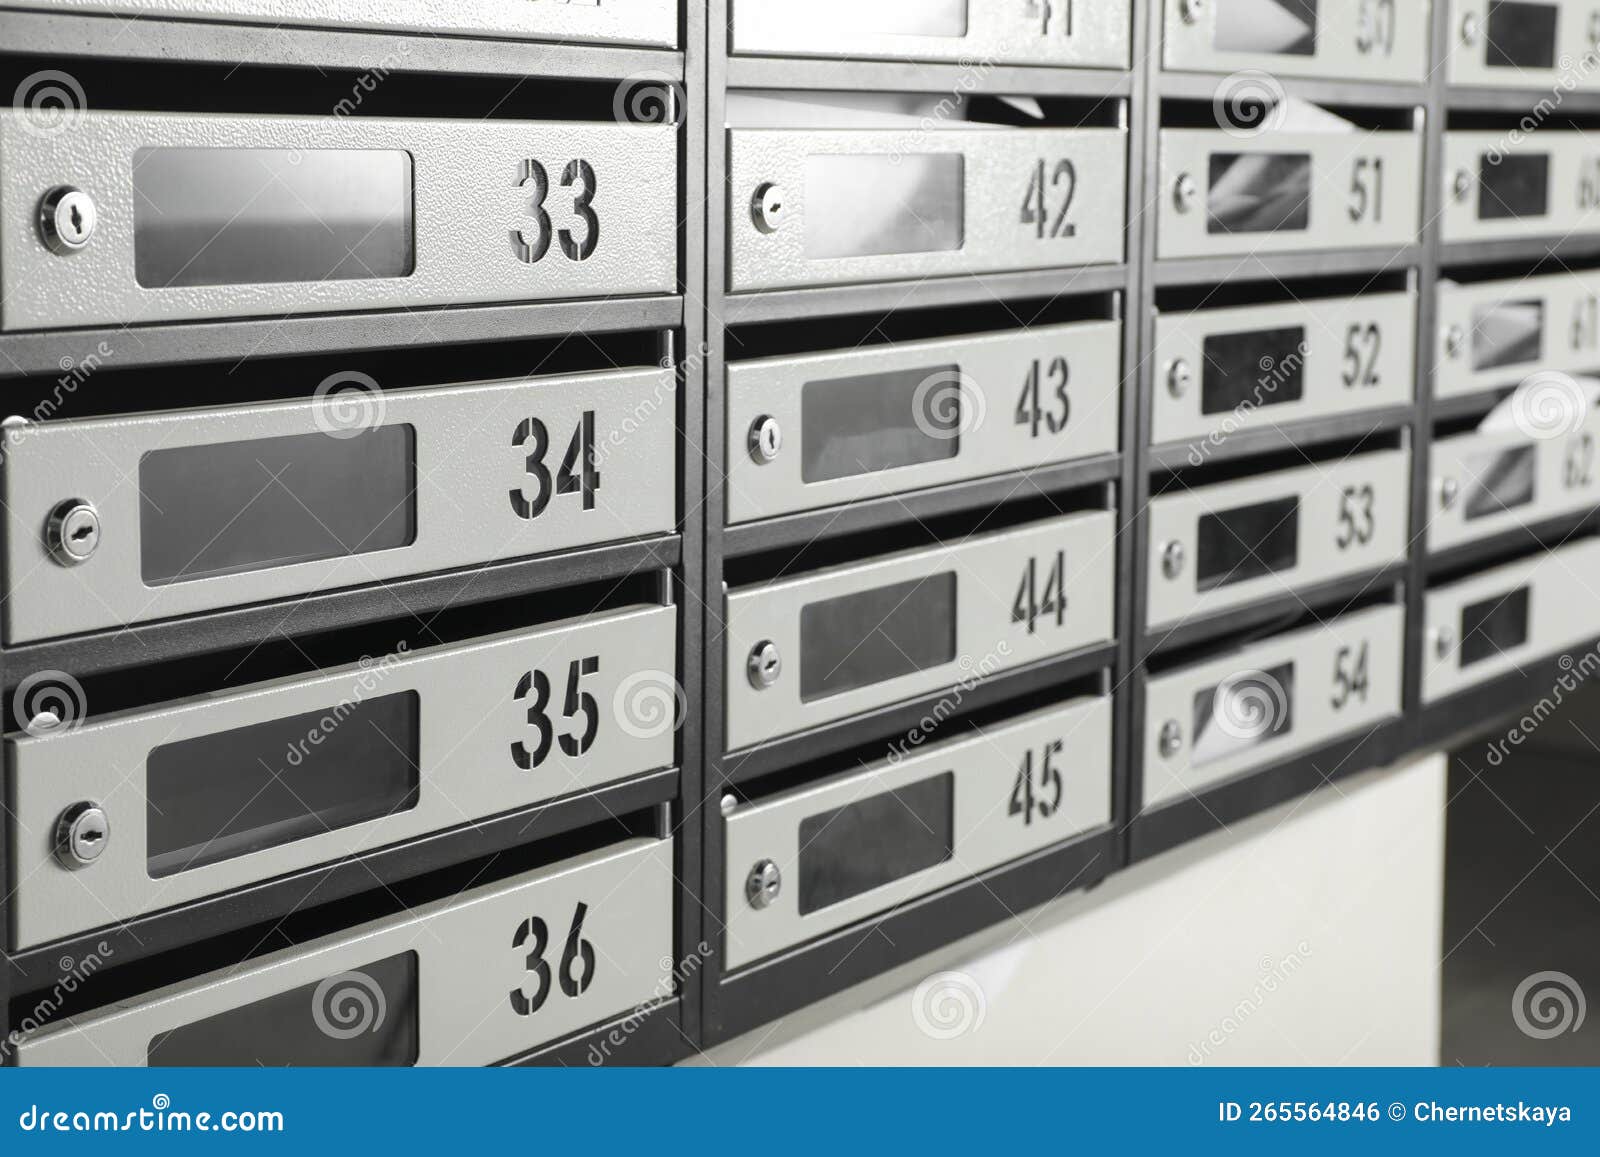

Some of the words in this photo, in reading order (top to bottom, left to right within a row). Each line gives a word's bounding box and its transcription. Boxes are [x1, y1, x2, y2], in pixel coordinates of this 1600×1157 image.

[509, 158, 600, 264] 33
[1020, 159, 1077, 239] 42
[1348, 158, 1384, 223] 51
[1341, 322, 1381, 389] 52
[1015, 357, 1070, 438] 43
[508, 410, 601, 520] 34
[1335, 484, 1375, 551] 53
[1011, 550, 1067, 635] 44
[510, 655, 600, 770] 35
[1330, 642, 1369, 711] 54
[1007, 739, 1064, 826] 45
[510, 901, 596, 1017] 36
